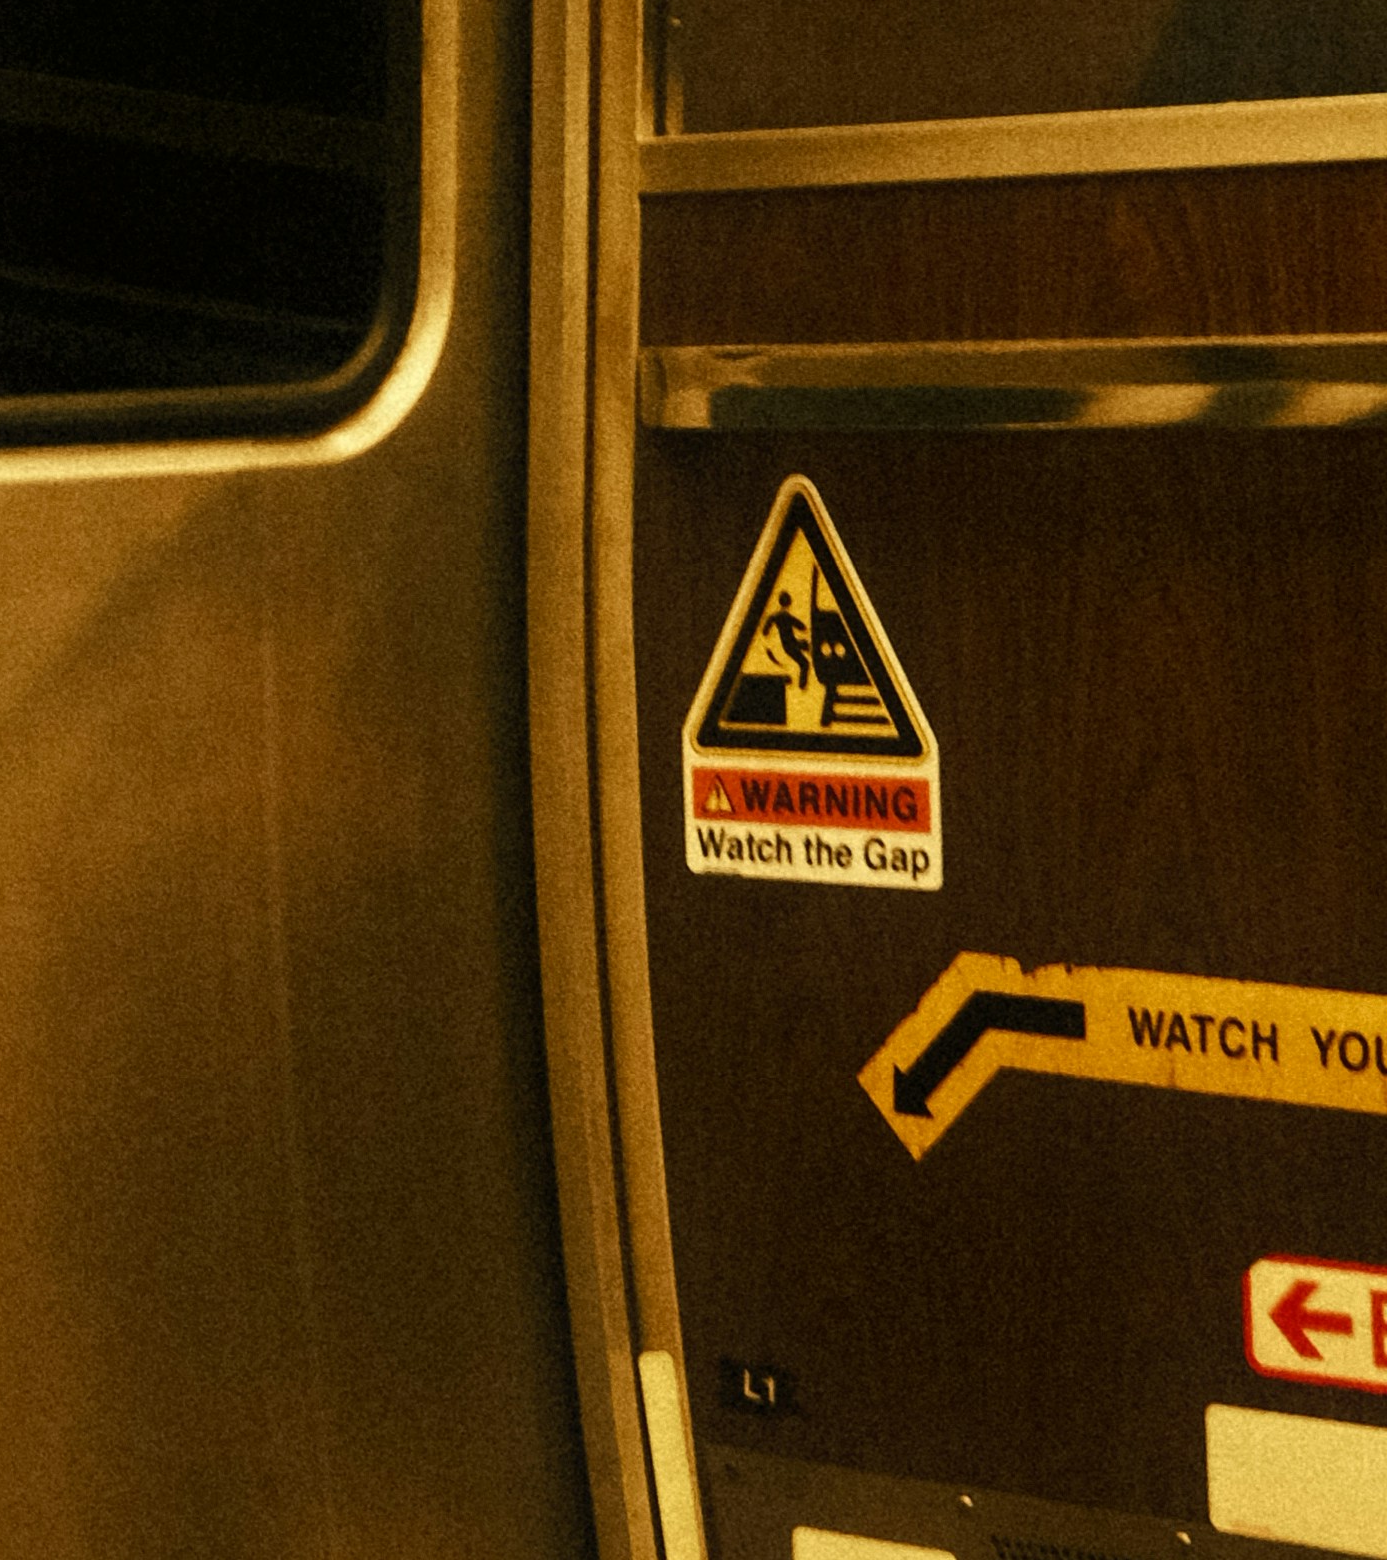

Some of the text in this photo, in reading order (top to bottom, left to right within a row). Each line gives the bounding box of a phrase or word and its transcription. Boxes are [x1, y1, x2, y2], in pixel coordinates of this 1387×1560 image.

[738, 777, 919, 825] WARNING
[695, 825, 930, 881] Watch the Gap
[1127, 1004, 1280, 1065] WATCH
